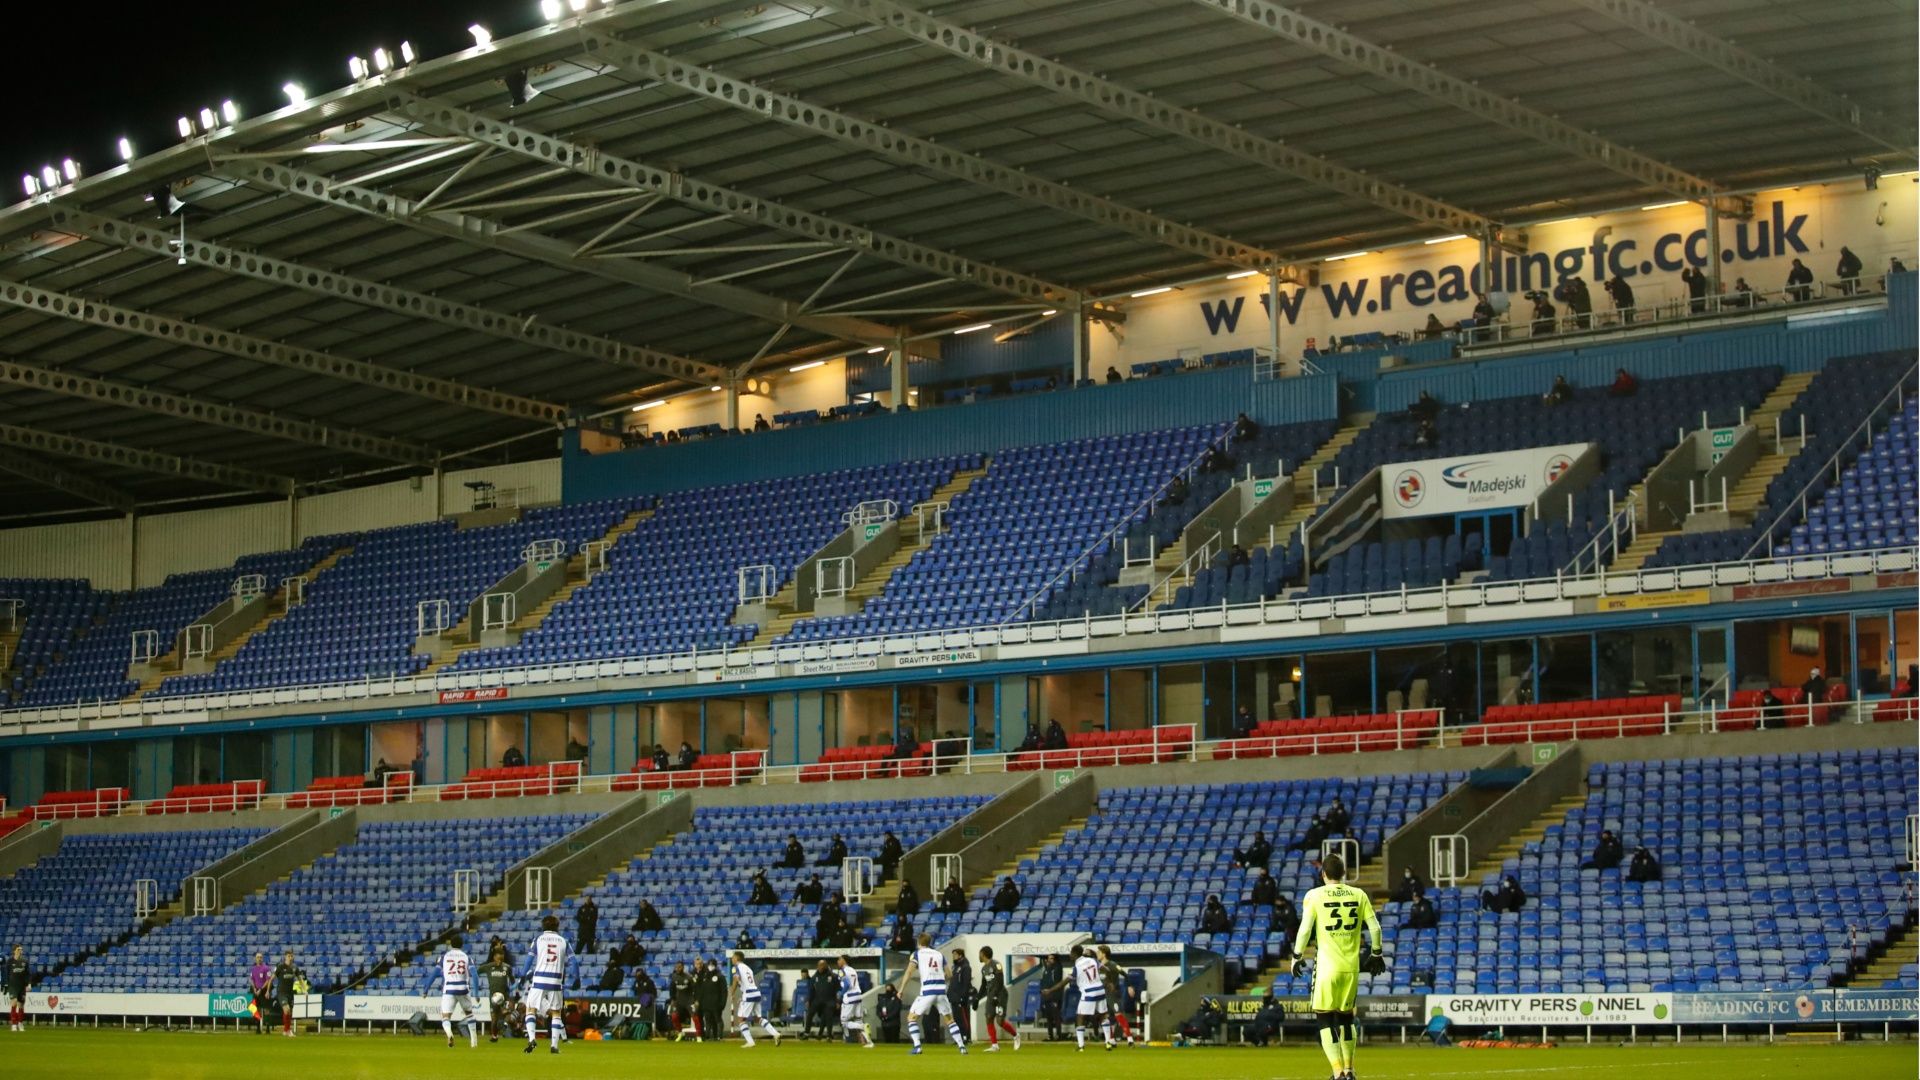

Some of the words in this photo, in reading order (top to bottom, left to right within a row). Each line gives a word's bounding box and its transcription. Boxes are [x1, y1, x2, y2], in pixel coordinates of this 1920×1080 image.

[1469, 474, 1527, 494] Madejski
[899, 654, 929, 665] GRAVITY
[803, 665, 818, 673] Sheet
[818, 664, 833, 672] Metal
[443, 692, 465, 700] RAPID
[1539, 750, 1551, 759] G7
[1058, 775, 1070, 784] G6
[1324, 902, 1359, 931] 33
[547, 944, 557, 962] 5
[447, 960, 466, 975] 28
[929, 957, 938, 971] 4
[850, 974, 857, 986] 7
[1083, 965, 1097, 982] 17
[590, 1003, 641, 1018] RAPIDZ
[1228, 1001, 1240, 1013] ALL
[1450, 999, 1521, 1012] GRAVITY
[1692, 1001, 1764, 1015] READING
[1767, 1001, 1789, 1014] FC
[1821, 998, 1919, 1012] REMEMBERS
[1521, 1014, 1570, 1022] Recruiters
